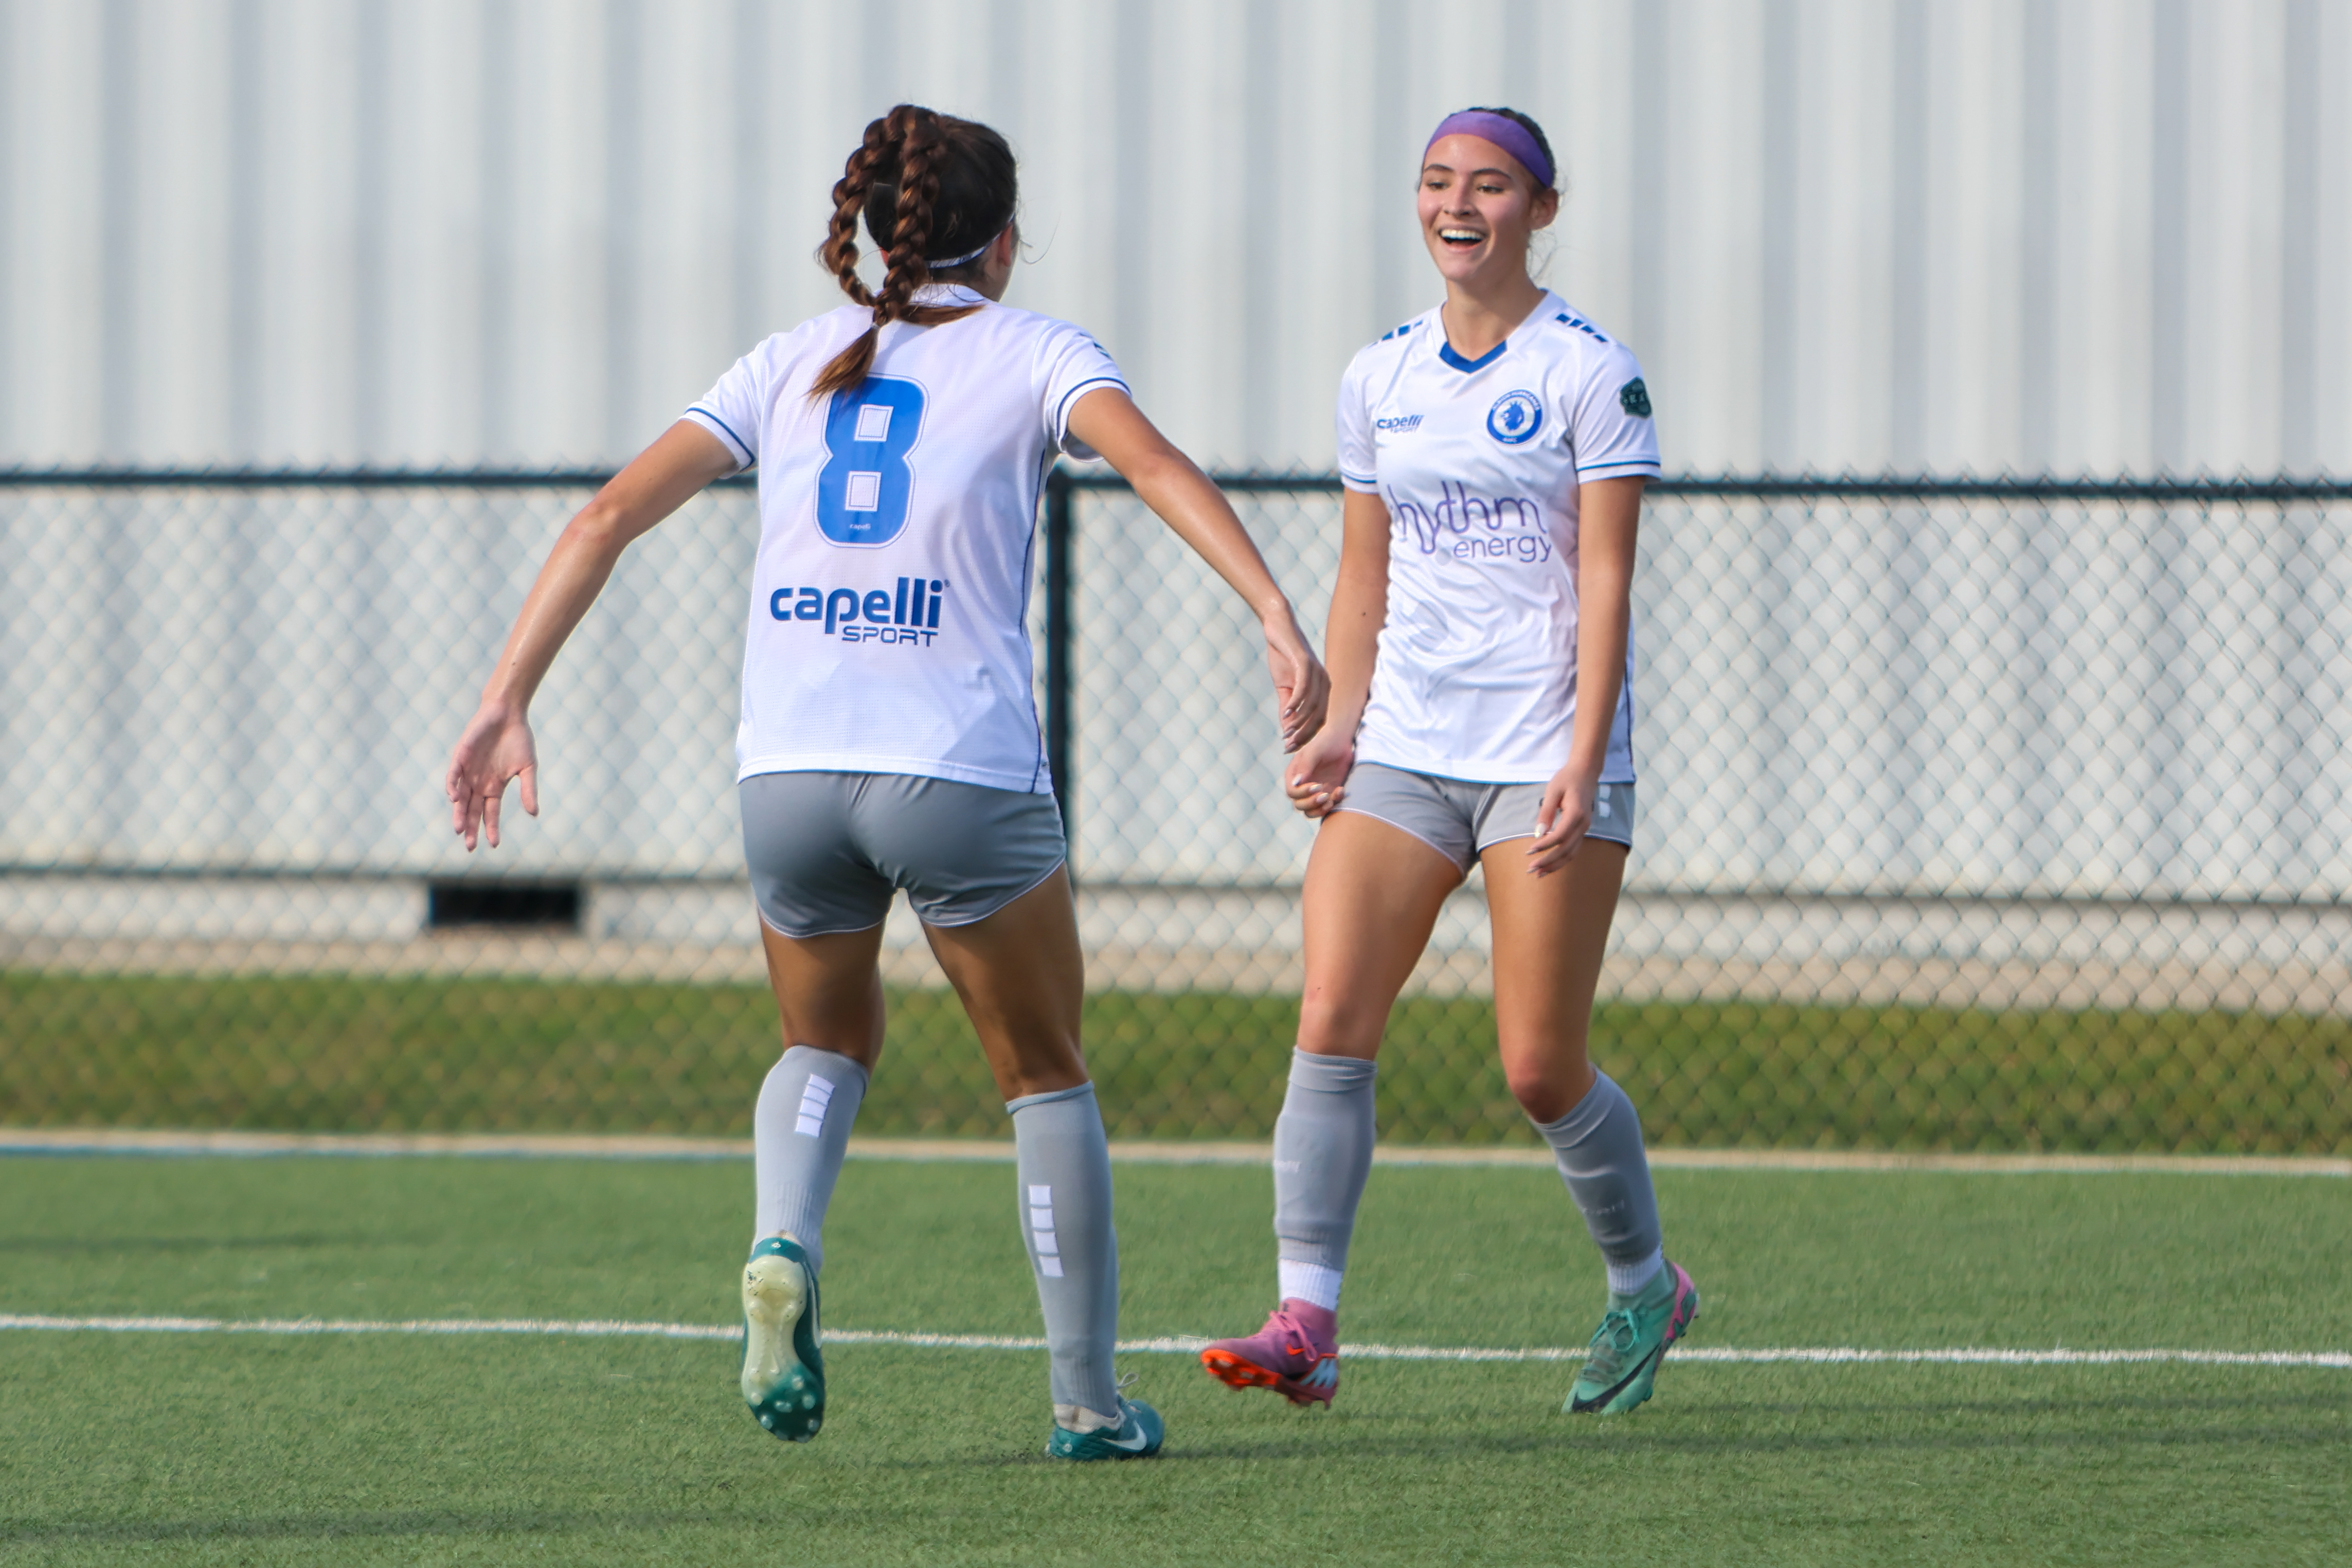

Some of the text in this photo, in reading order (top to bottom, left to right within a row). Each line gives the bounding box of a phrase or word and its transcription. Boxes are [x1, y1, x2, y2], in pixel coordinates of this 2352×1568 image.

[814, 373, 930, 549] 8
[1453, 536, 1551, 562] energy
[770, 576, 943, 635] capelli
[841, 625, 939, 647] SPORT
